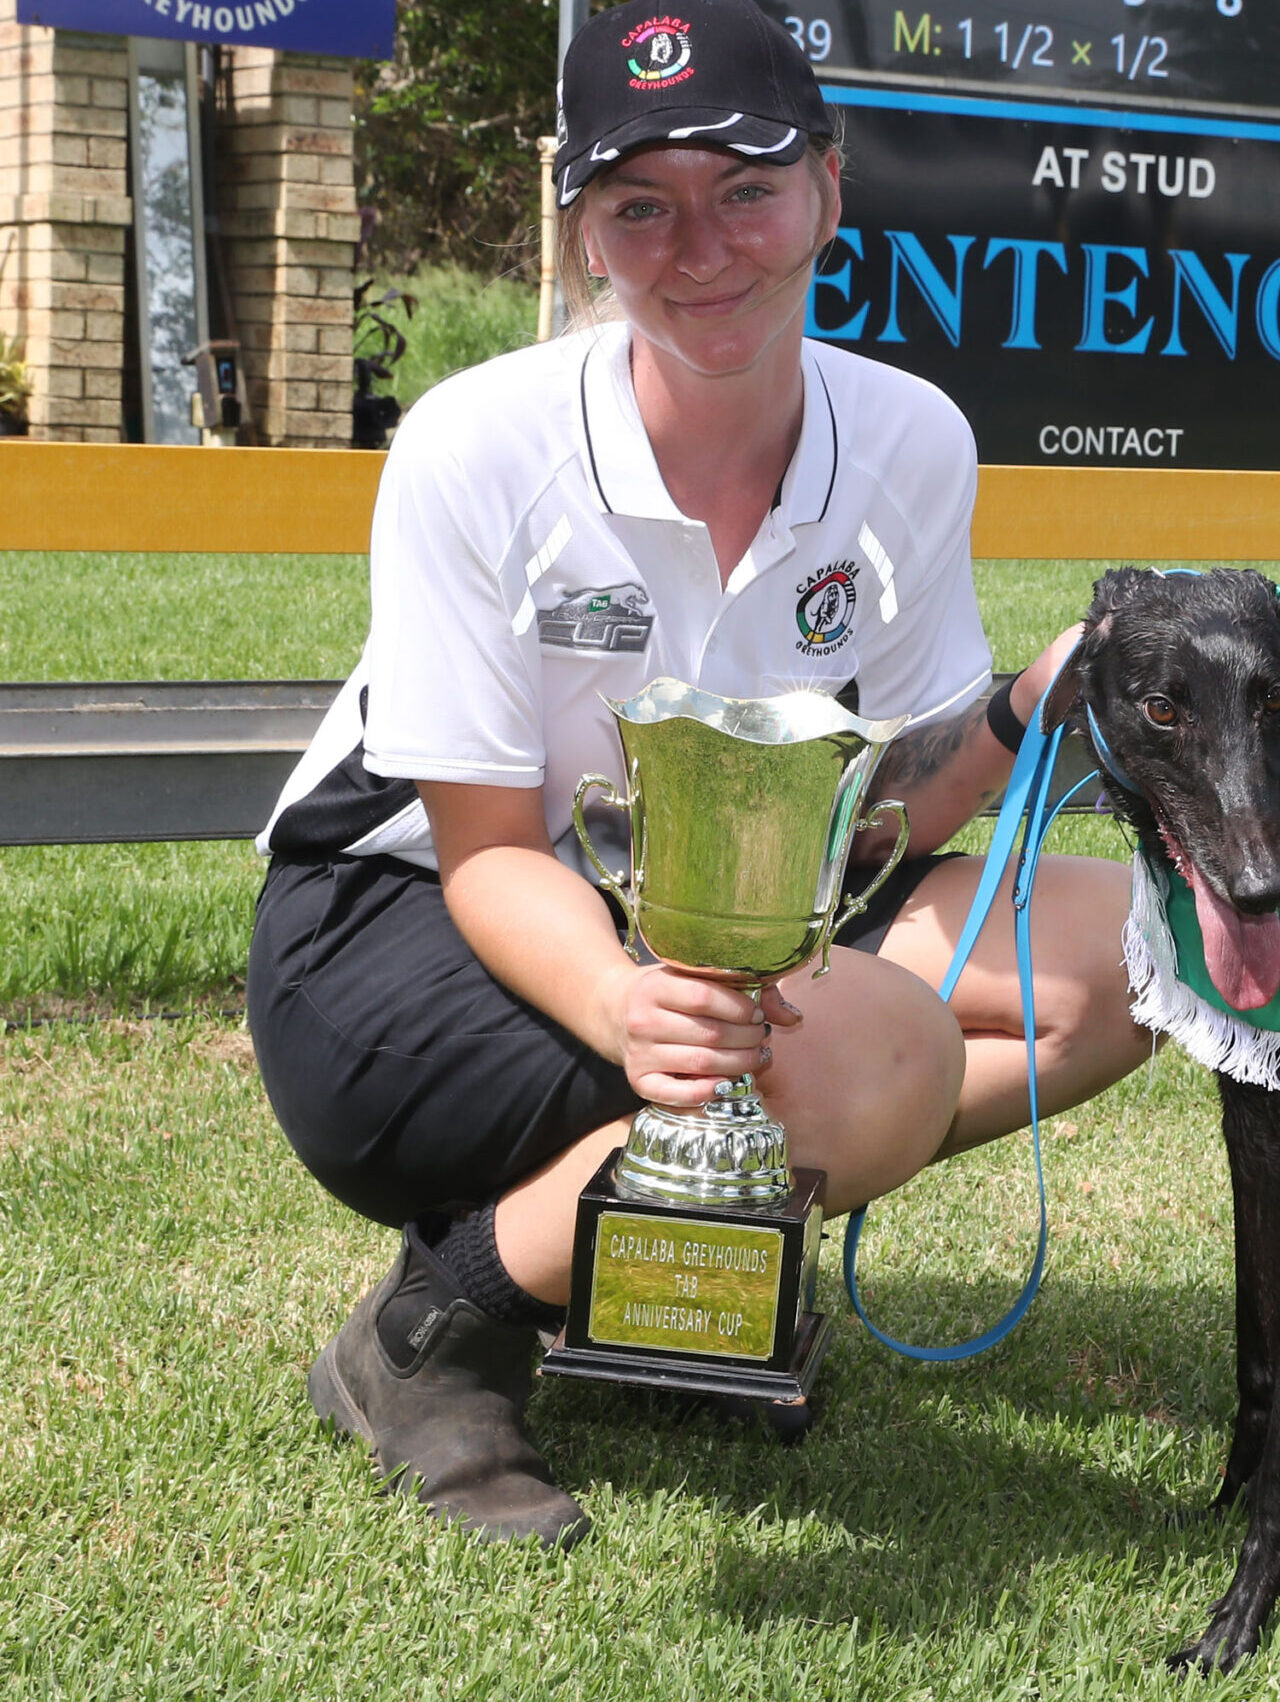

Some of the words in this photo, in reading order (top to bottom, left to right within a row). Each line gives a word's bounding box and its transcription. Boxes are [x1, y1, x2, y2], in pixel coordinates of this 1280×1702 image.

[145, 0, 306, 32] EYHOUND
[621, 16, 692, 48] CAPALABA
[894, 10, 942, 56] M:
[957, 18, 973, 59] 1
[994, 23, 1055, 69] 1/2
[1111, 33, 1169, 80] 1/2
[629, 66, 696, 90] GREYHOUNDS
[1033, 146, 1089, 190] AT
[1101, 152, 1216, 199] STUD
[1039, 424, 1184, 458] CONTACT
[796, 559, 860, 594] CAPALABA
[592, 598, 608, 608] TAB
[795, 628, 853, 657] GREYHOUNDS
[610, 1234, 675, 1264] CAPALABA
[683, 1241, 768, 1273] GREYHOUNDS
[675, 1274, 698, 1299] TAB
[623, 1302, 712, 1333] ANNIVERSARY
[718, 1312, 743, 1336] CUP
